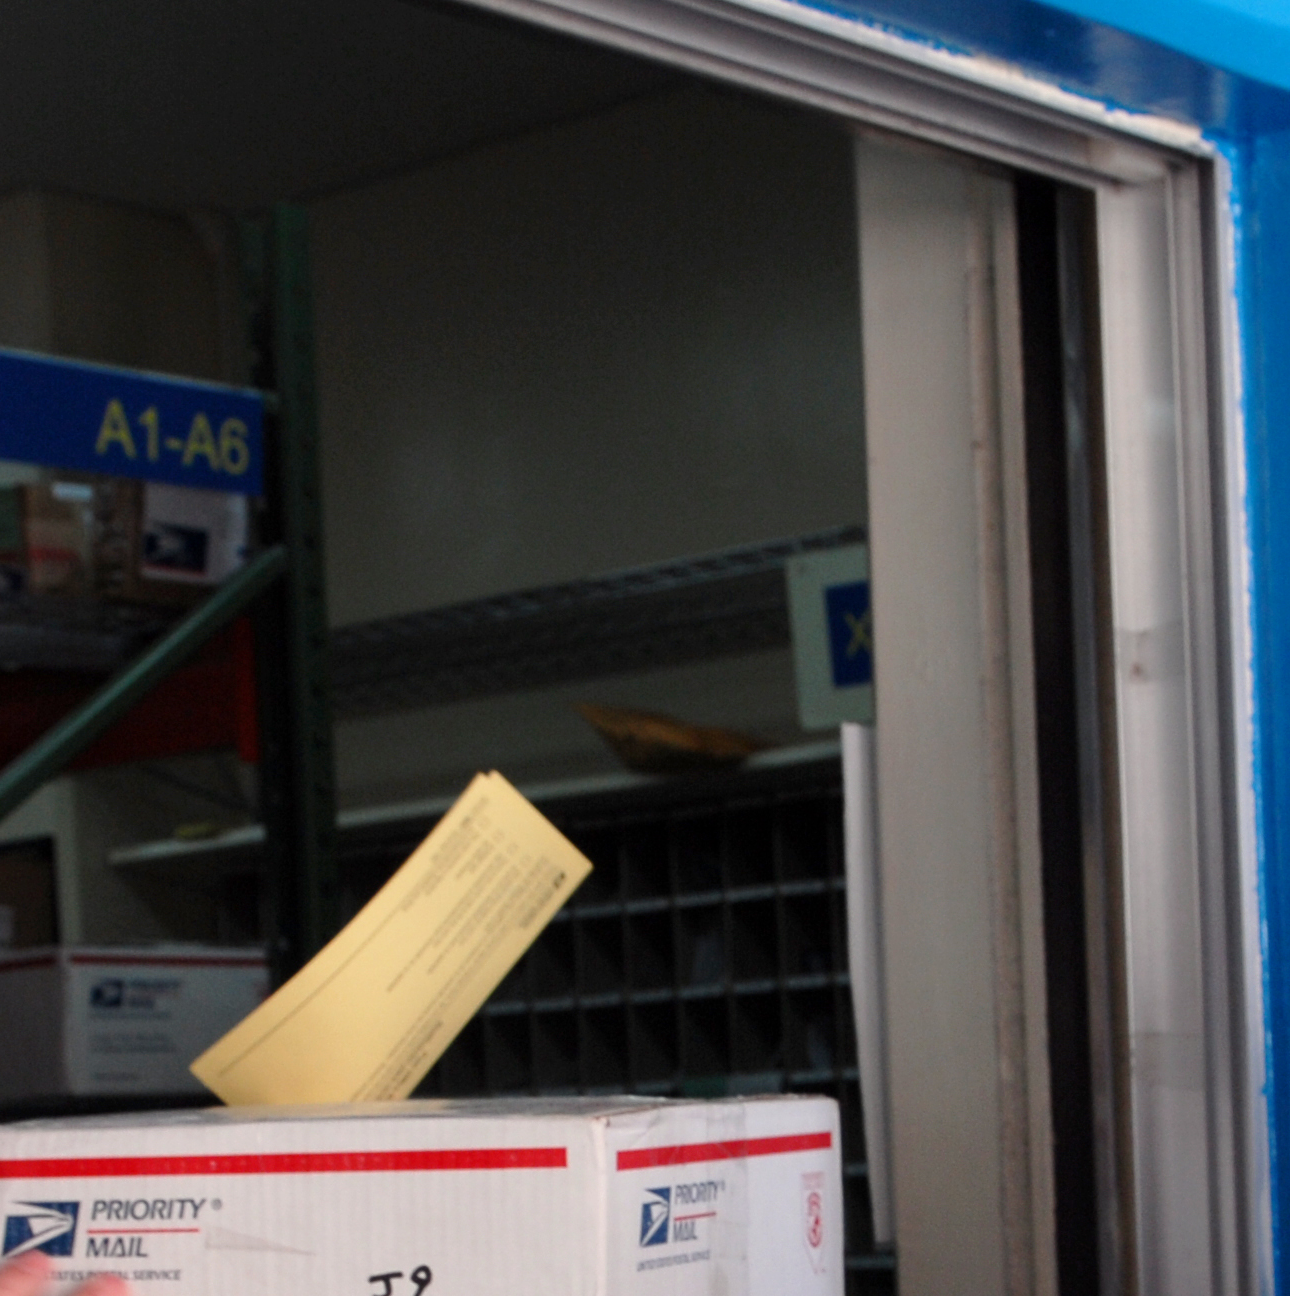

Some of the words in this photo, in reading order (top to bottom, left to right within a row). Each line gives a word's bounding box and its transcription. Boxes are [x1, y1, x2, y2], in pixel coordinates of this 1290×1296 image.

[95, 397, 250, 476] A1-A6
[675, 1181, 718, 1204] PRIORITY
[91, 1198, 207, 1221] PRIORITY
[86, 1237, 149, 1258] MAIL
[46, 1269, 84, 1282] TATES
[132, 1269, 182, 1281] SERVICE
